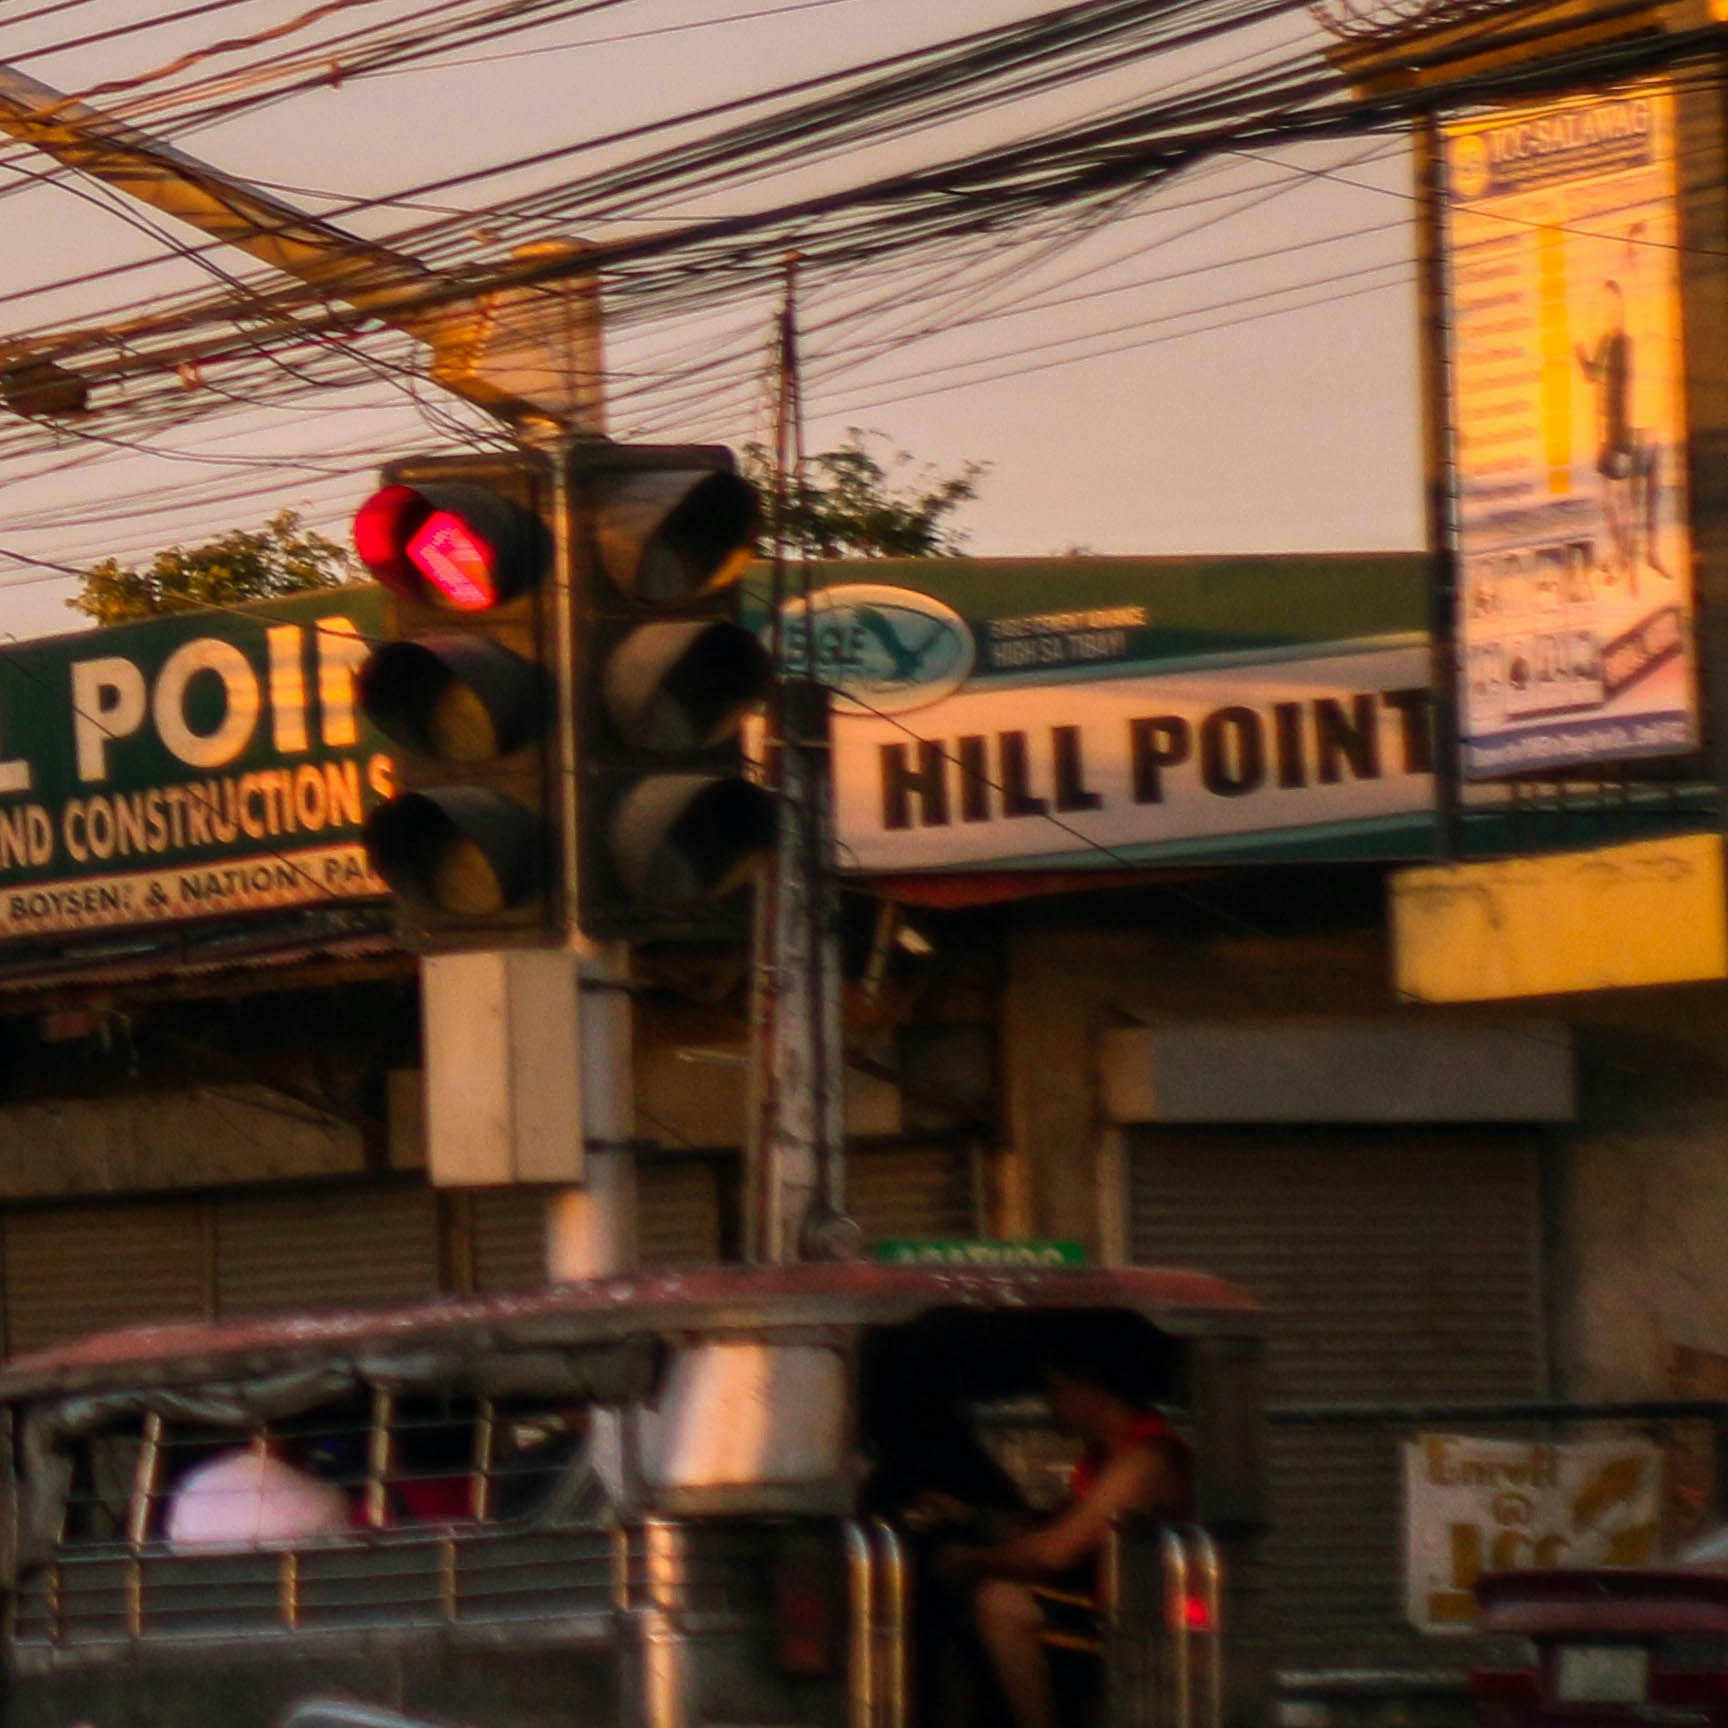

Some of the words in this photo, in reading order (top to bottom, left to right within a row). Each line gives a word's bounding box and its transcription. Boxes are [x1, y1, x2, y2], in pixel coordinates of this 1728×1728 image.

[880, 726, 1102, 830] HILL
[1129, 687, 1430, 804] POINT
[62, 762, 364, 864] CONSTRUCTION
[150, 878, 168, 906] &
